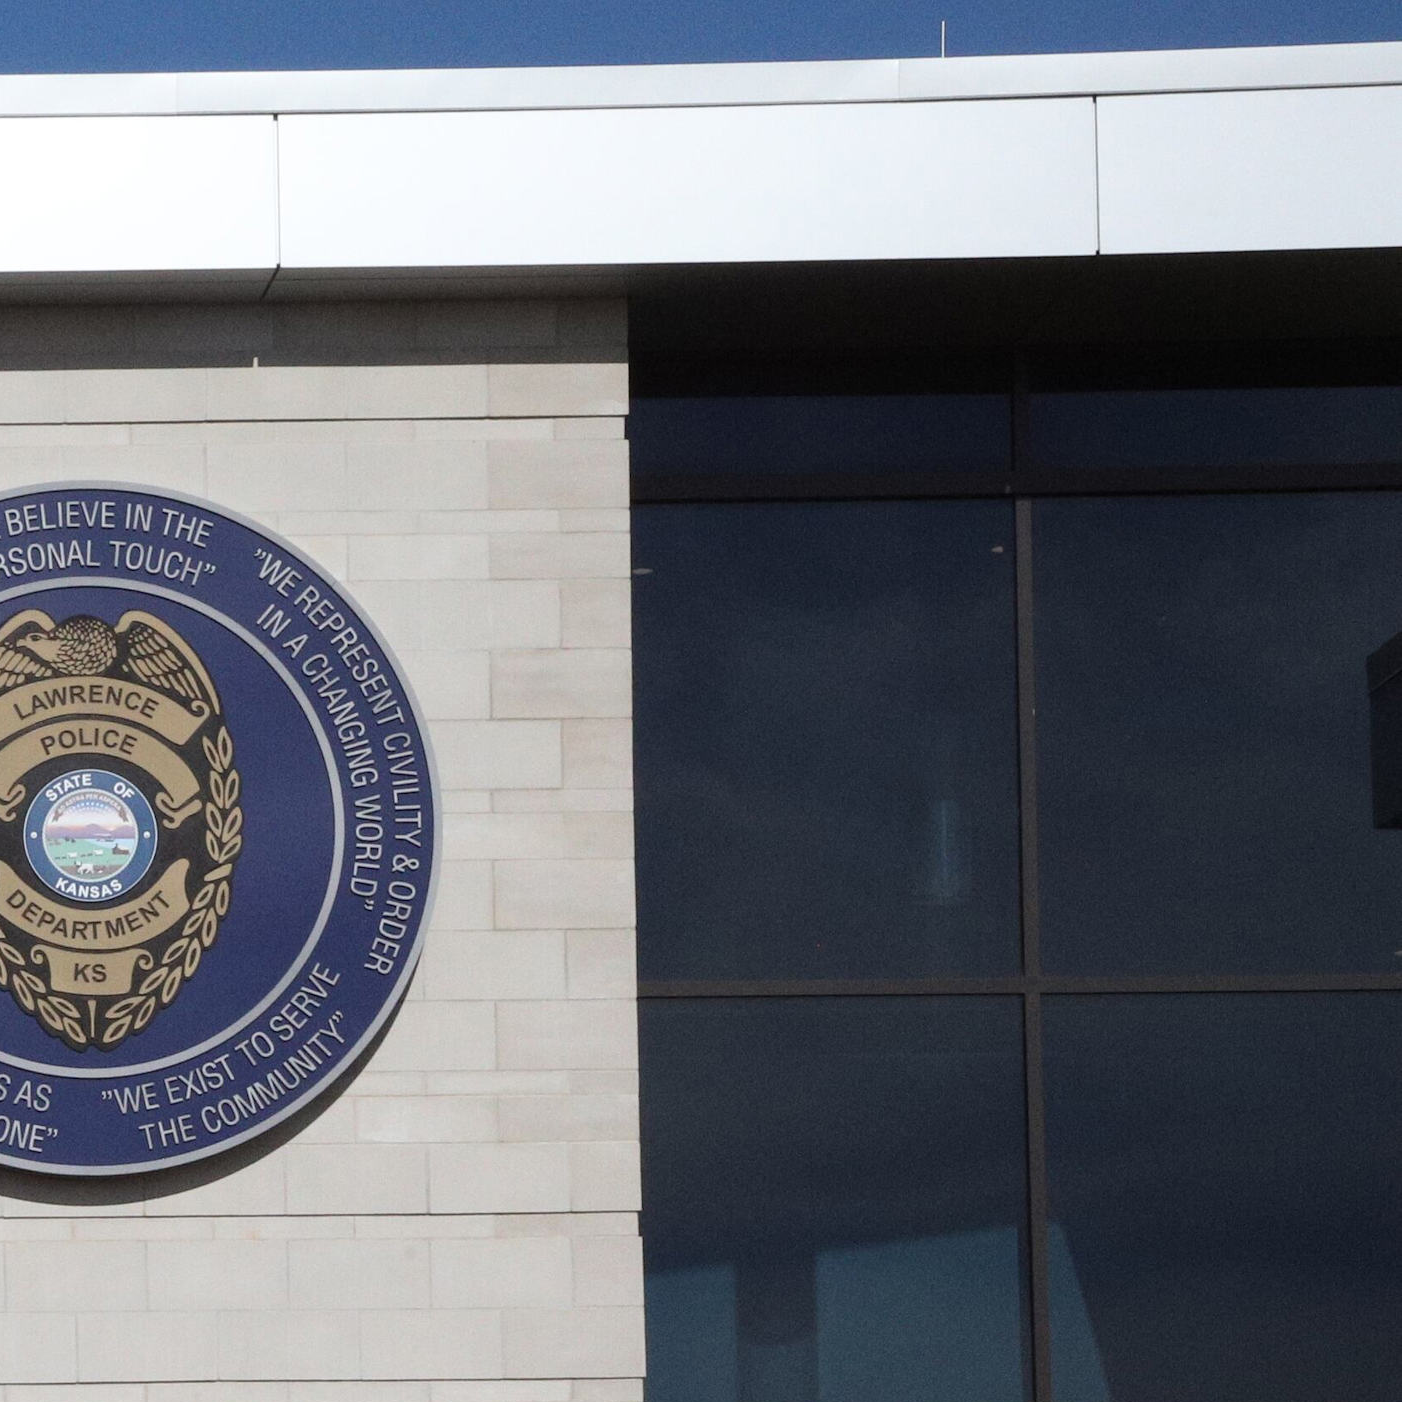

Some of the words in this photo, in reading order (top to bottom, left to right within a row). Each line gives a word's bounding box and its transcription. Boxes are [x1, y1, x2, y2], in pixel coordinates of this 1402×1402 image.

[4, 501, 116, 537] BELIEVE
[124, 503, 151, 533] IN
[162, 508, 215, 548] THE
[294, 584, 405, 727] REPRESENT
[13, 684, 160, 721] LAWRENCE
[256, 604, 292, 639] IN
[282, 633, 309, 660] A
[301, 653, 379, 790] CHANGING
[40, 728, 138, 756] POLICE
[45, 773, 93, 802] STATE
[113, 782, 135, 800] OF
[383, 732, 423, 850] CIVILITY
[392, 853, 421, 874] &
[55, 877, 123, 899] KANSAS
[6, 890, 171, 941] DEPARTMENT
[363, 882, 417, 976] ORDER
[73, 963, 108, 983] KS
[167, 1056, 236, 1104] EXIST
[234, 1031, 275, 1068] TO
[279, 962, 341, 1043] SERVE
[13, 1082, 53, 1113] AS
[138, 1115, 196, 1151] THE
